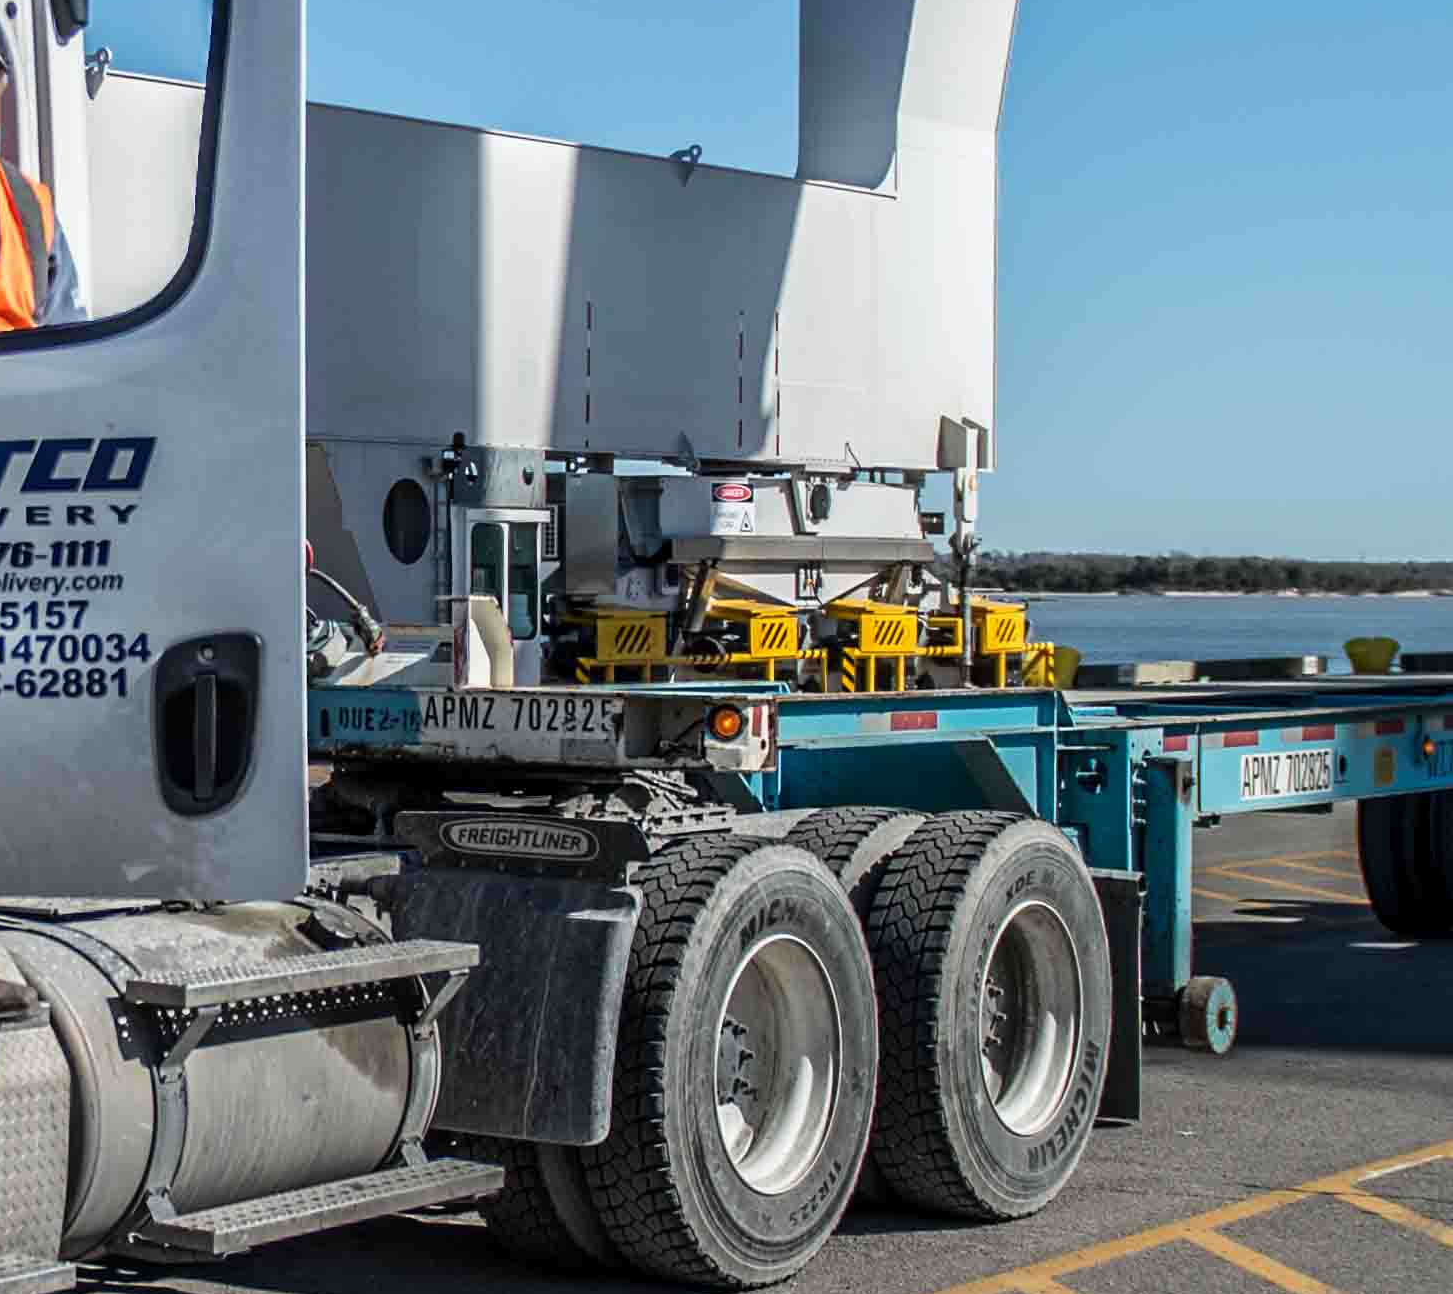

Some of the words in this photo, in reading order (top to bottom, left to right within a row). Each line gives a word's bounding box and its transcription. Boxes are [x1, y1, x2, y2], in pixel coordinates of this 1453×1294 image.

[423, 696, 495, 730] APMZ
[1242, 755, 1280, 796] APMZ
[1286, 751, 1331, 792] 702825
[457, 826, 582, 850] FREIGHTLINER
[1025, 1040, 1100, 1170] MICHELIN
